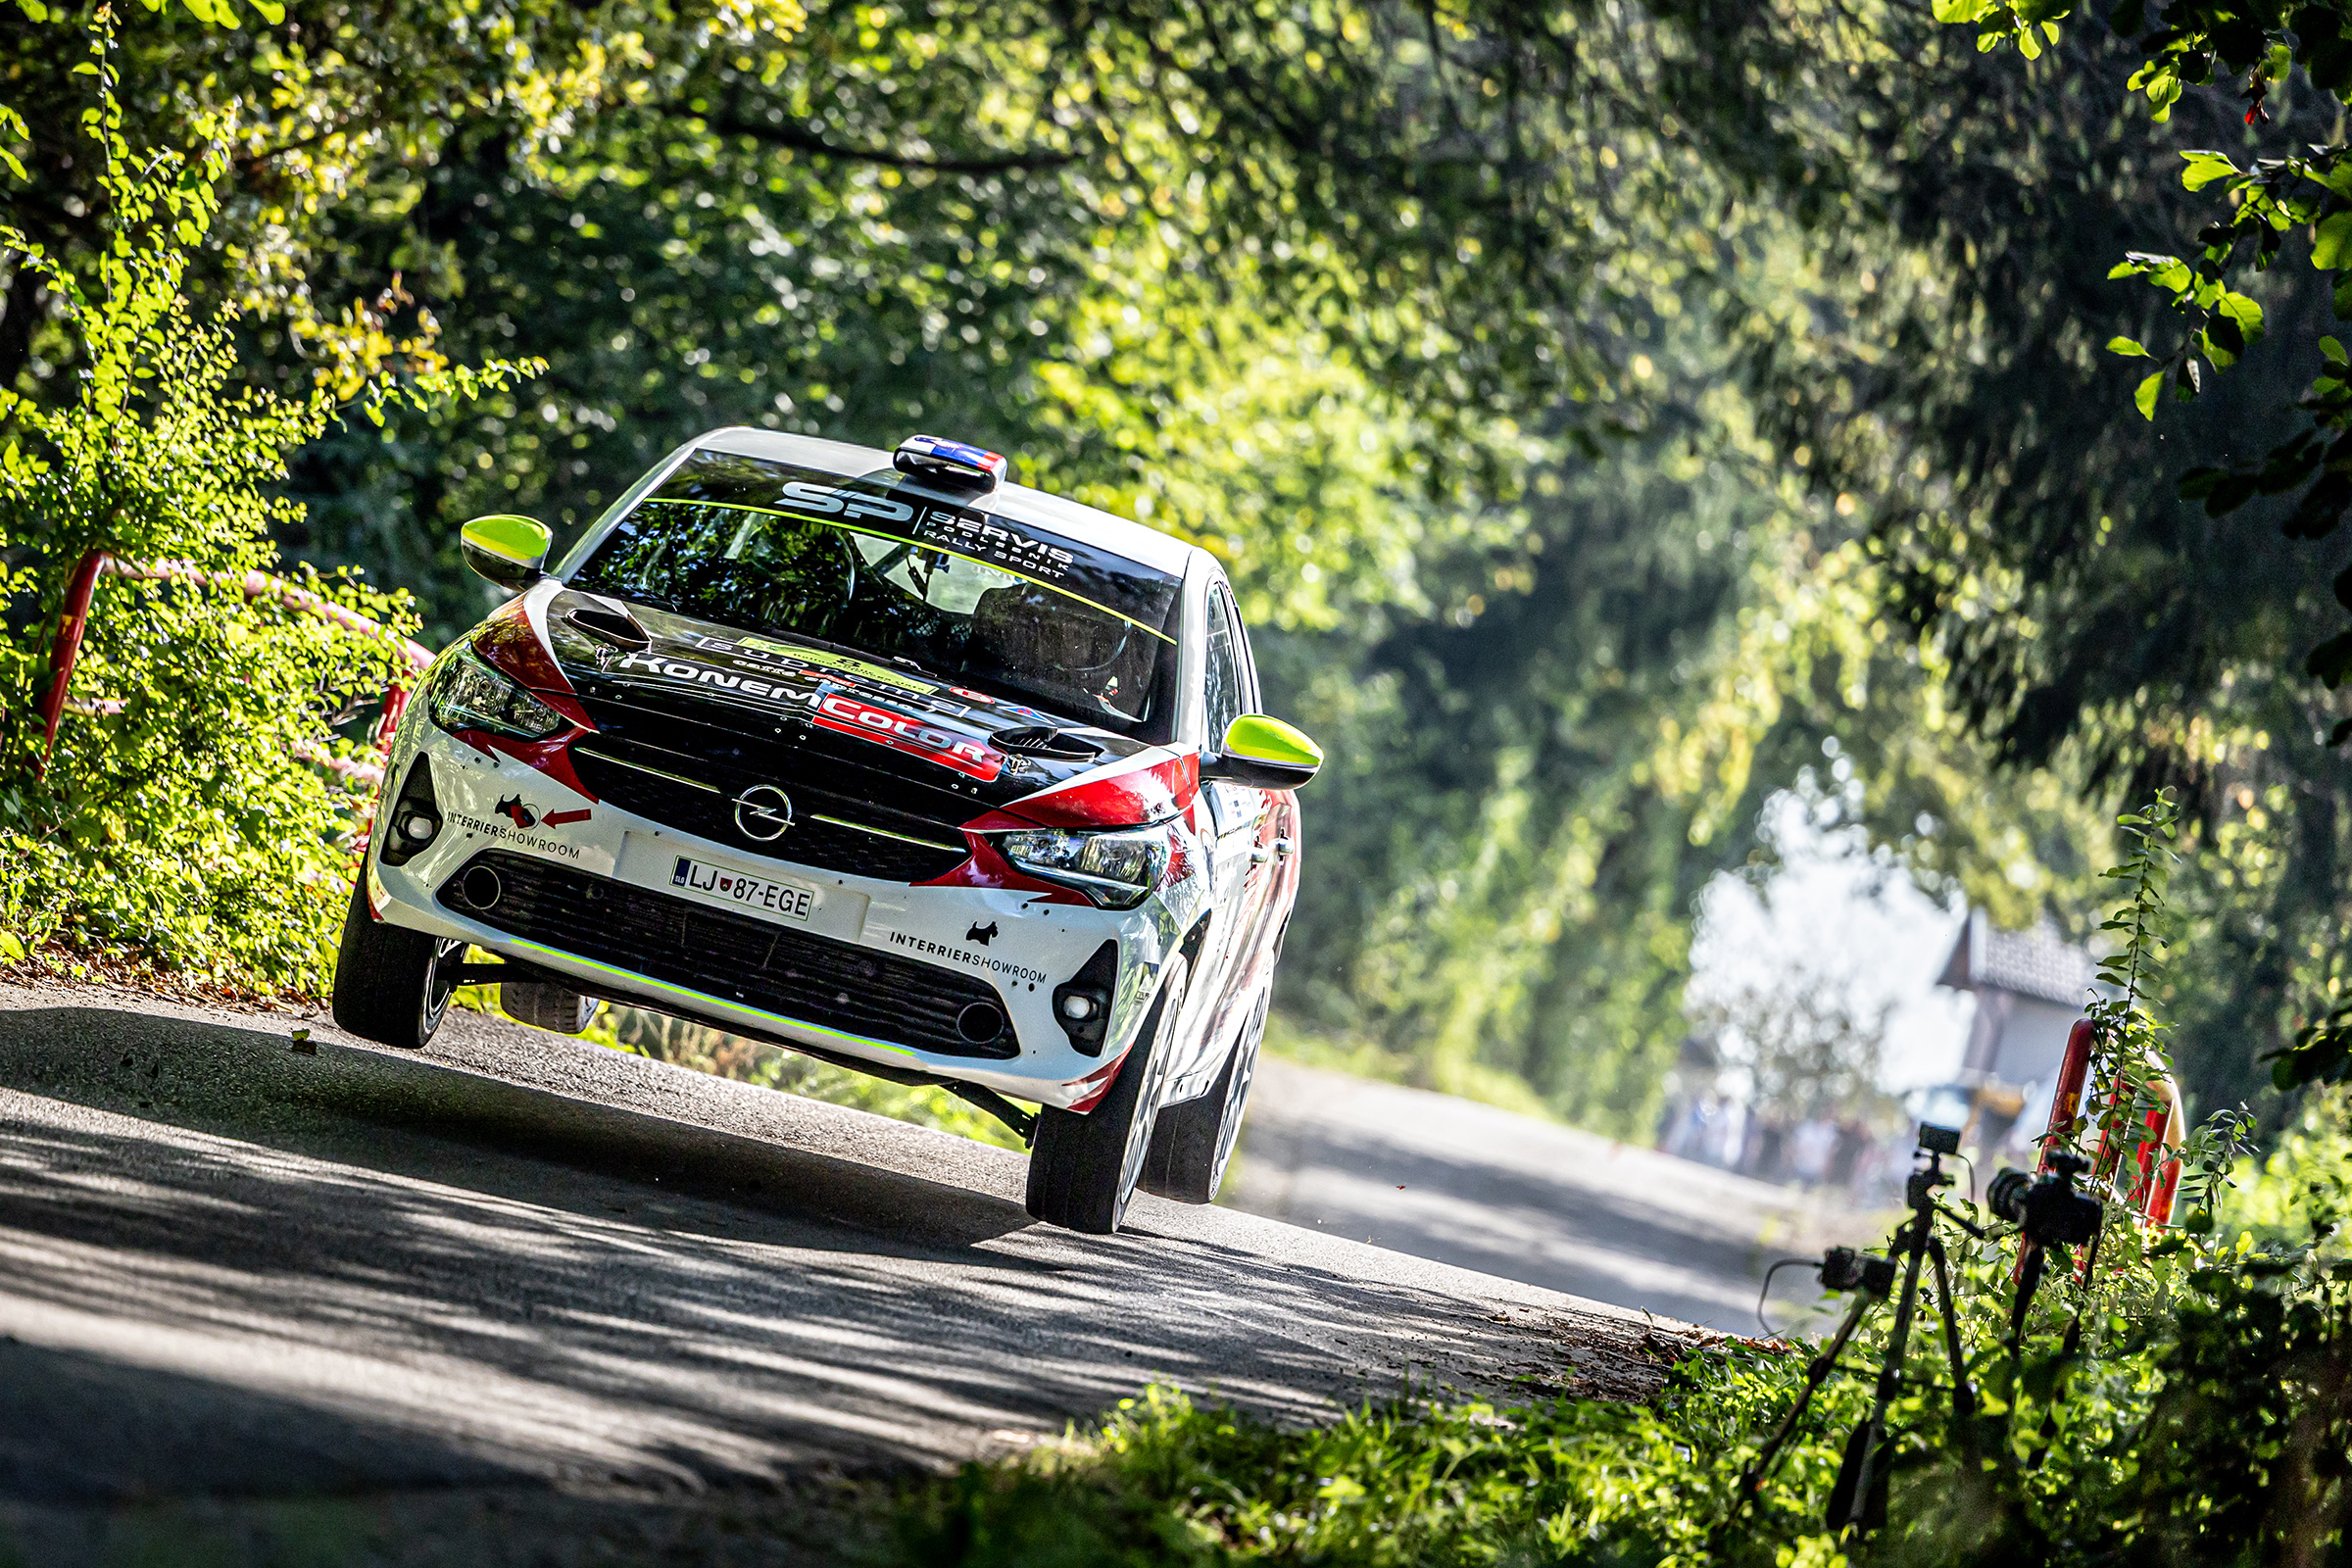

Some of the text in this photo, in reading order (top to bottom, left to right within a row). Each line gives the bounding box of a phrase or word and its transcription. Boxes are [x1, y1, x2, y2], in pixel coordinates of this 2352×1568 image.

[774, 481, 913, 520] SP
[923, 530, 987, 552] RALLY
[994, 550, 1065, 579] SPORT
[930, 511, 1074, 564] SERVIS
